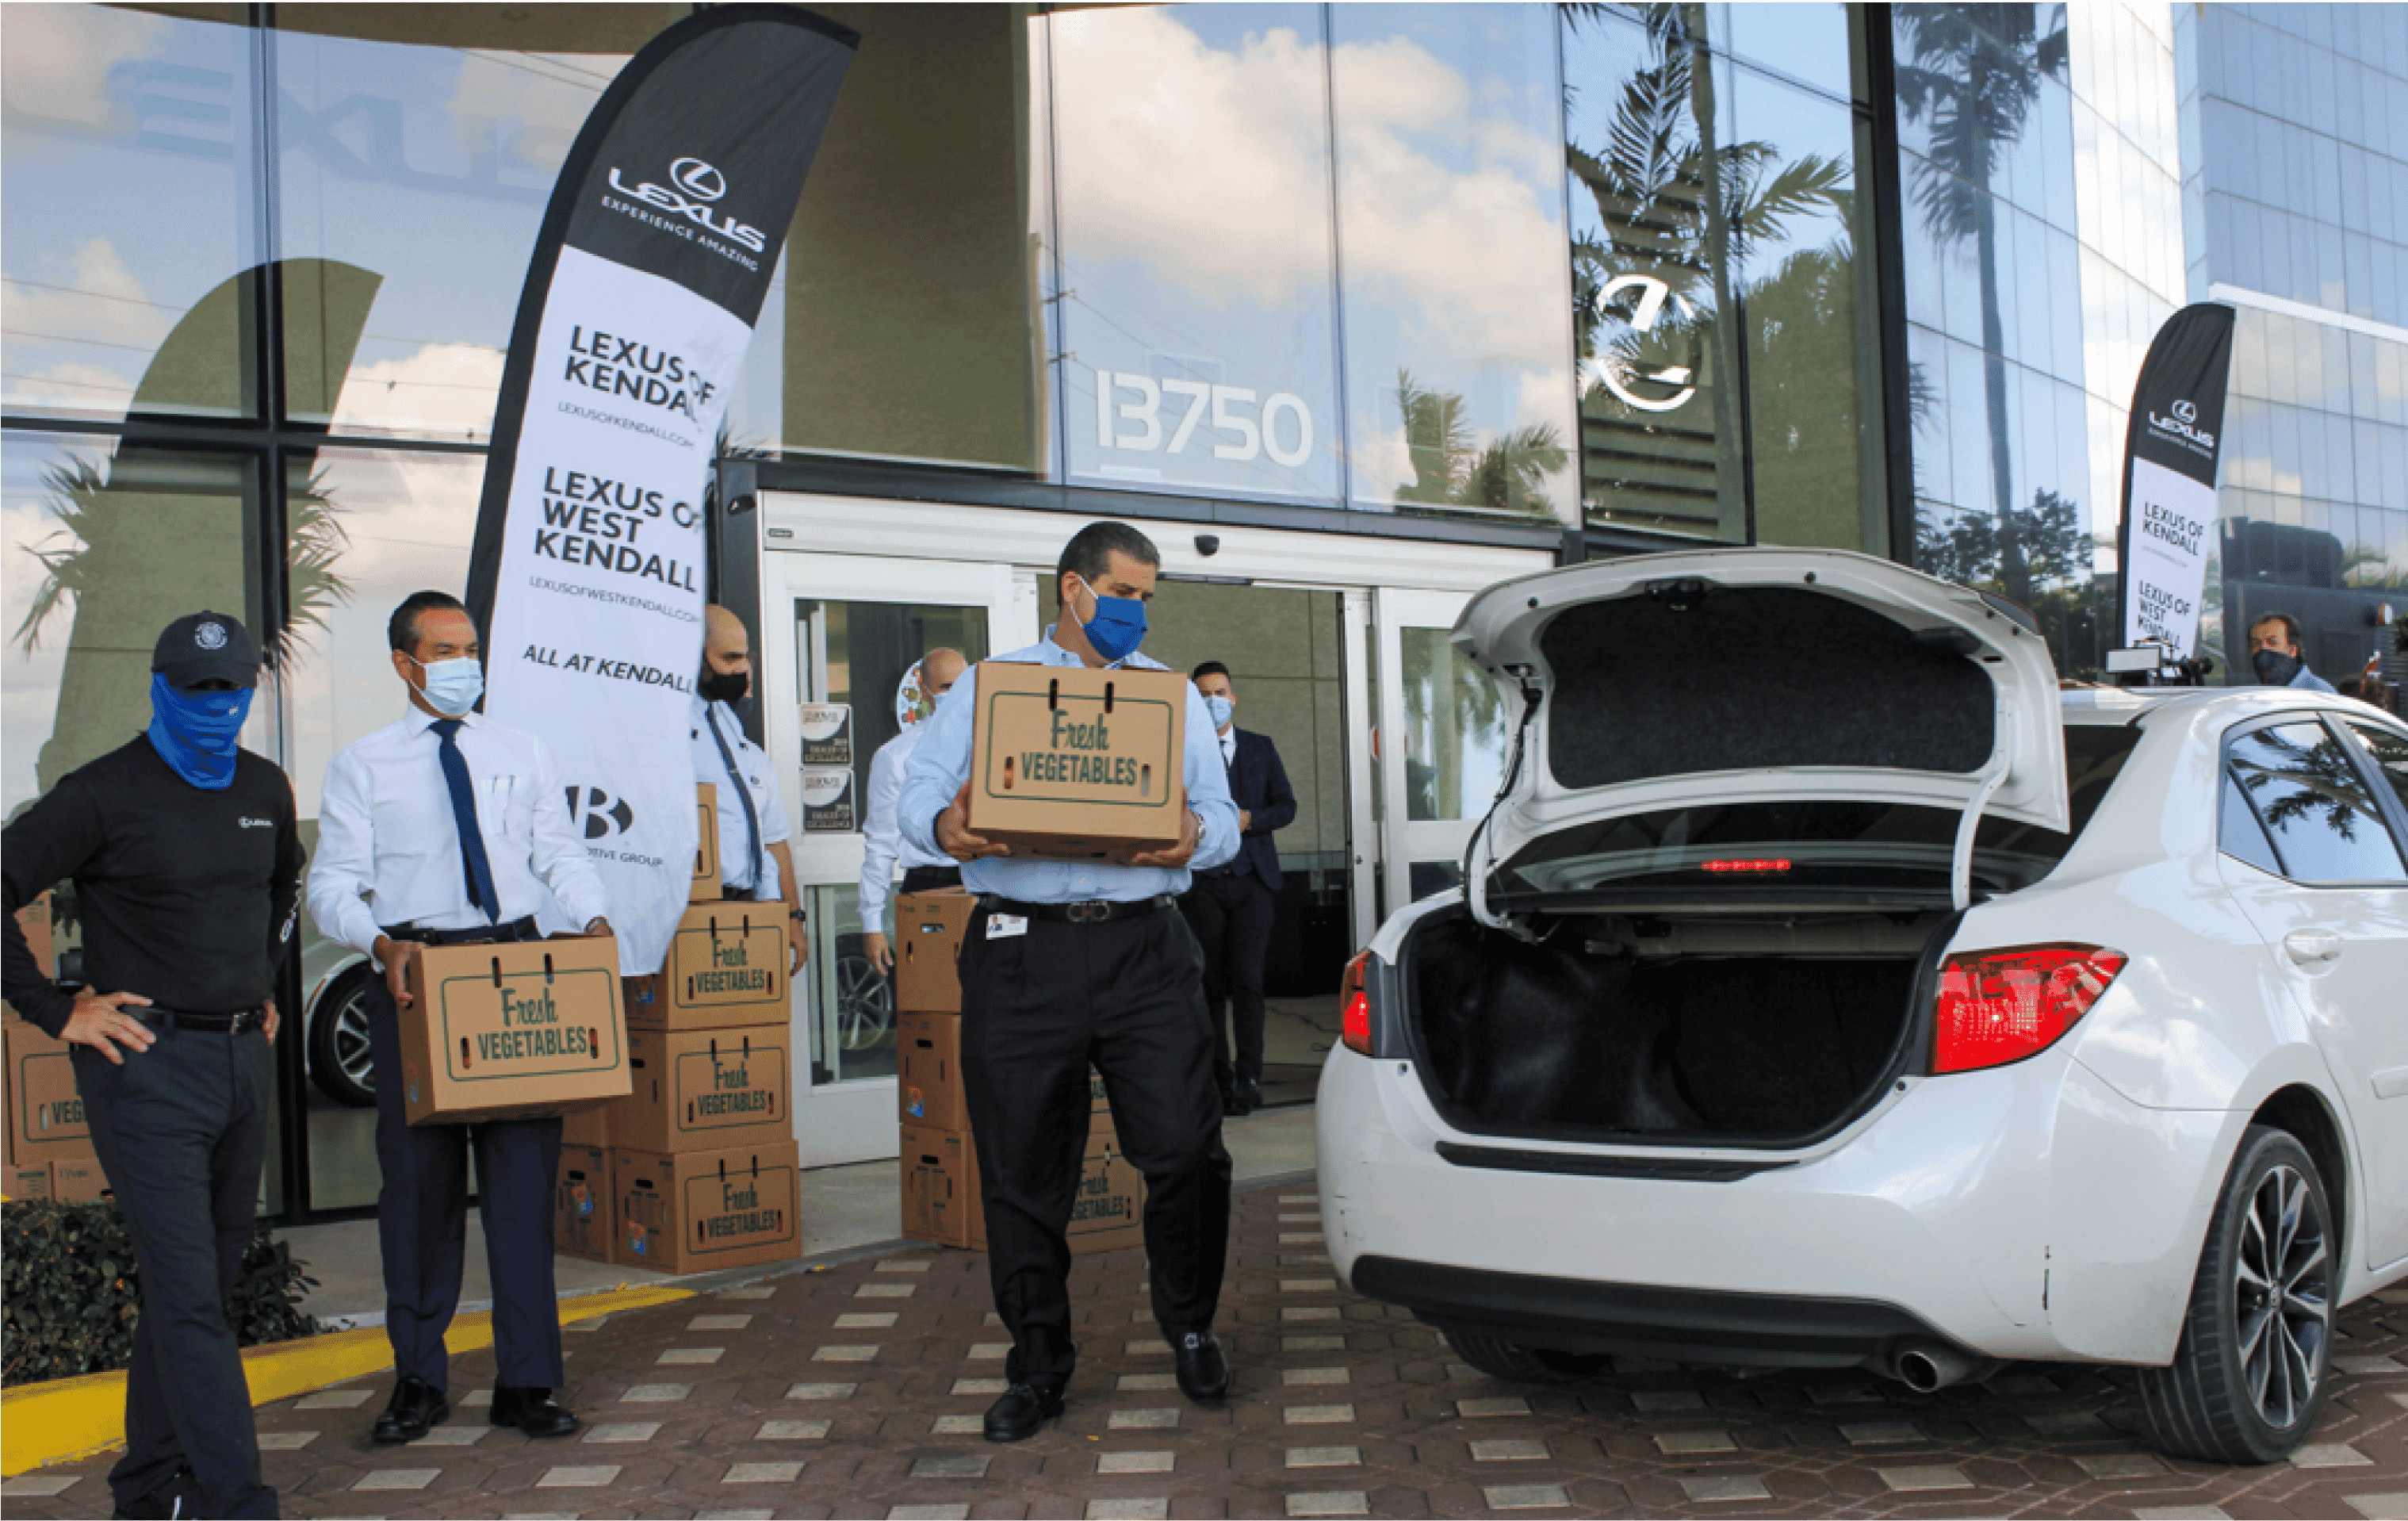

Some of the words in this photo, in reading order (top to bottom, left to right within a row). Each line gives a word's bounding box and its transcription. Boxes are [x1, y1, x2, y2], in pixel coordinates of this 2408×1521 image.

[609, 167, 765, 252] LEXUS
[602, 195, 695, 240] EXPERIENCE
[698, 235, 758, 272] AMAZING
[570, 324, 684, 382] LEXUS
[564, 354, 699, 424] KENDA
[1097, 370, 1313, 467] 13750
[2148, 408, 2215, 449] LEXUS
[544, 465, 664, 518] LEXUS
[542, 496, 644, 543] WEST
[2144, 500, 2186, 532] LEXUS
[2142, 519, 2198, 556] KENDALL
[533, 527, 697, 594] KENDALL
[2138, 580, 2173, 610] LEXUS
[522, 643, 559, 668] ALL
[563, 653, 595, 673] AT
[1051, 710, 1110, 750] Fresh
[1020, 753, 1138, 787] VEGETABLES
[695, 969, 765, 992] VEGETABLES
[500, 987, 559, 1028] Fresh
[477, 1026, 588, 1061] VEGETABLES
[697, 1090, 767, 1117] VEGETABLES
[707, 1209, 779, 1239] VEGETABLES
